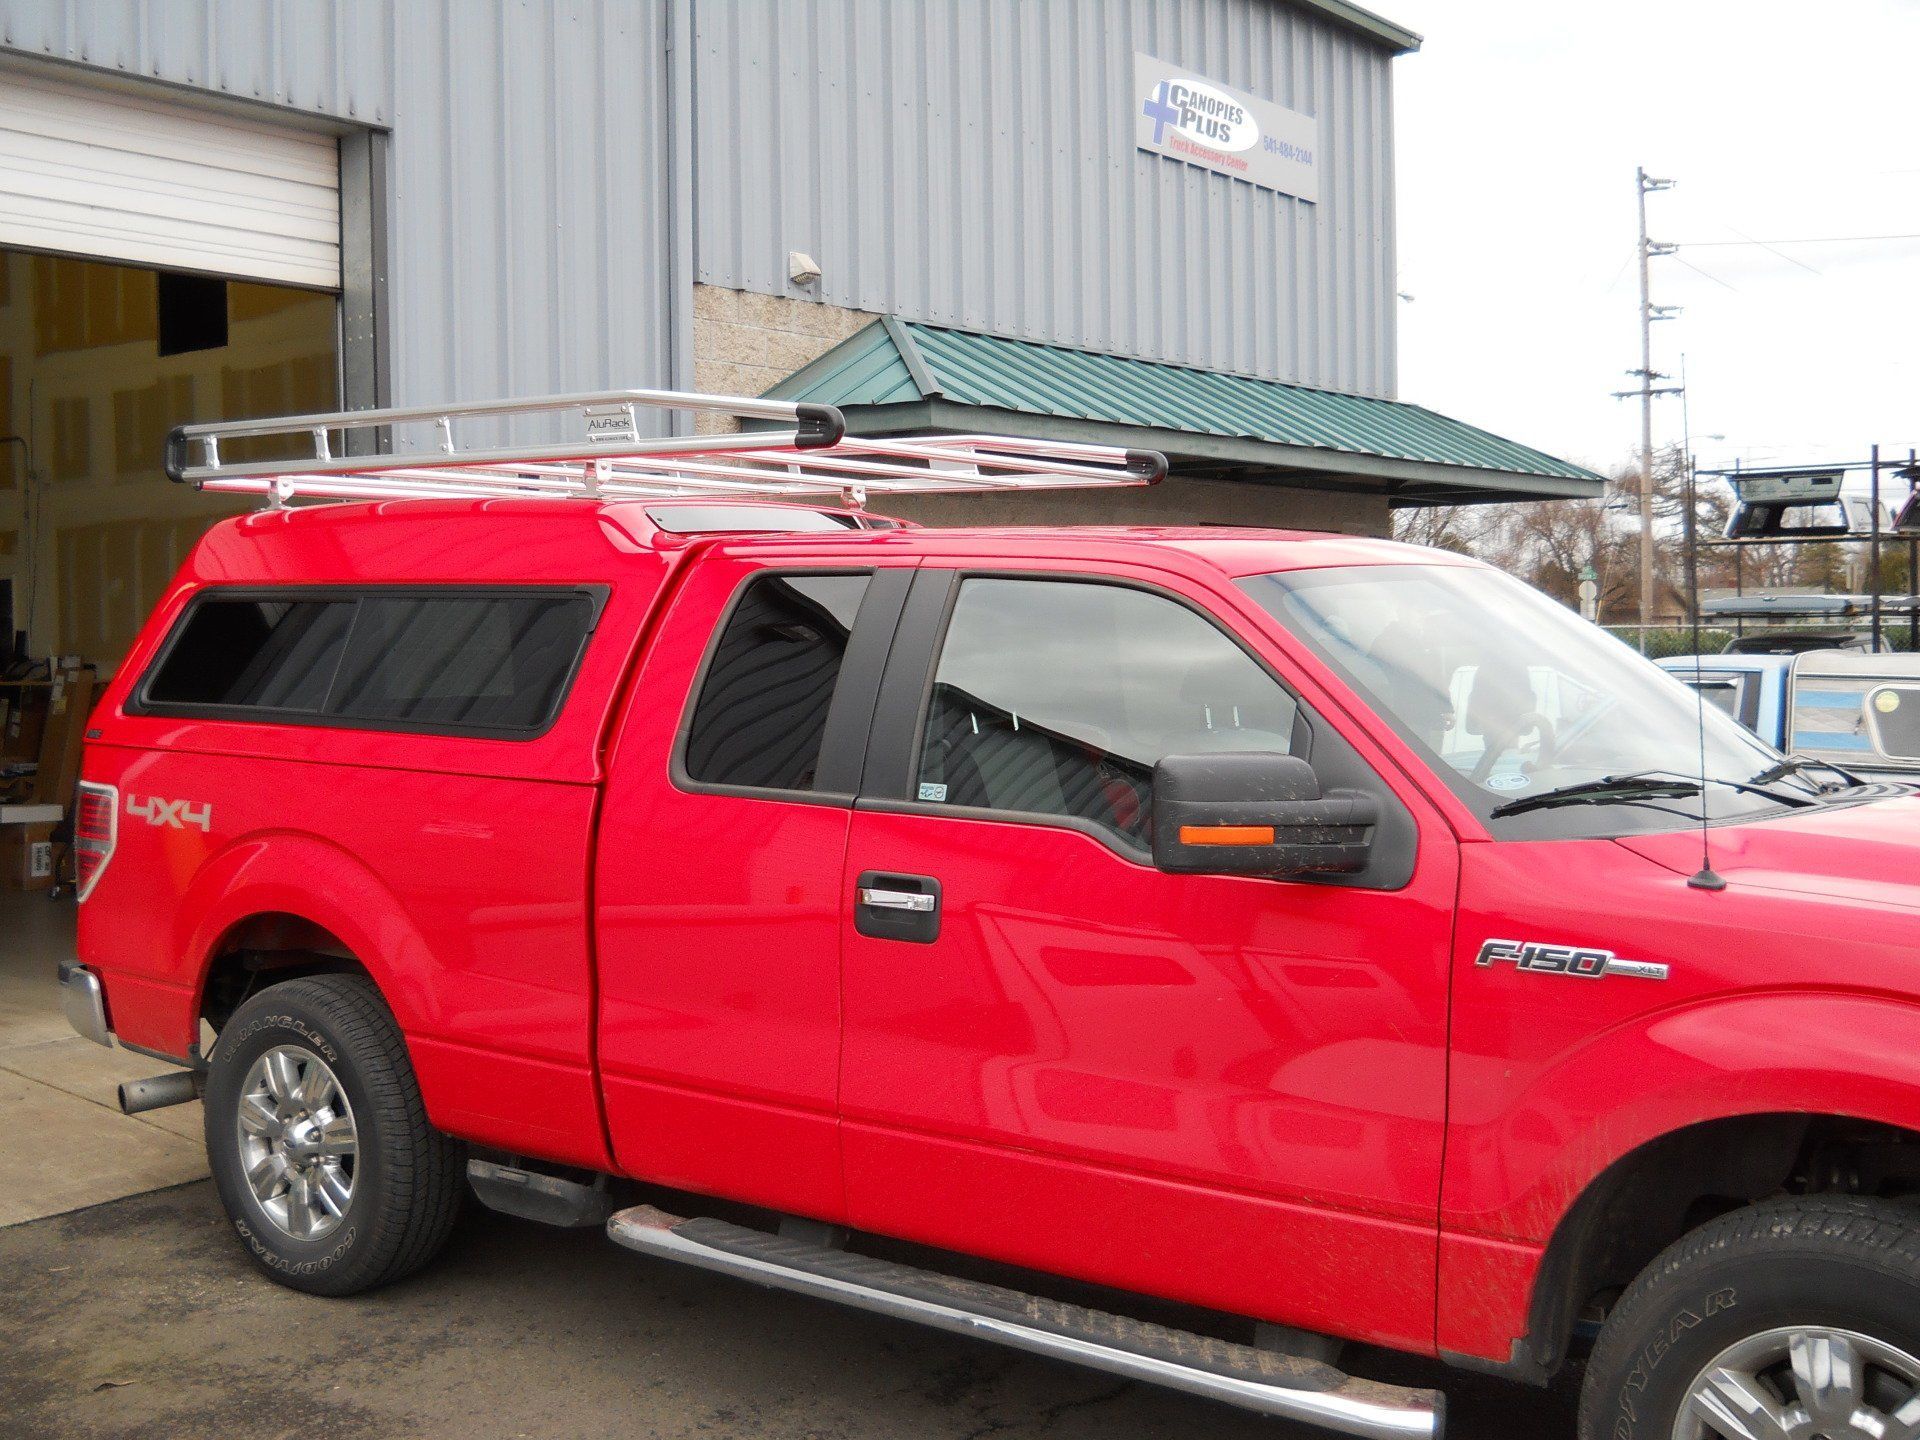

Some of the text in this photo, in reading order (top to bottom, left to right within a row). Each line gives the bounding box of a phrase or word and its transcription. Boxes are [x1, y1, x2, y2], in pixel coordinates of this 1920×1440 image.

[1170, 84, 1243, 125] CANOPIES
[1179, 107, 1231, 143] PLUS
[588, 418, 630, 431] AluRack
[1475, 938, 1664, 979] F-150 XLT
[235, 1218, 357, 1275] GOODYEAR
